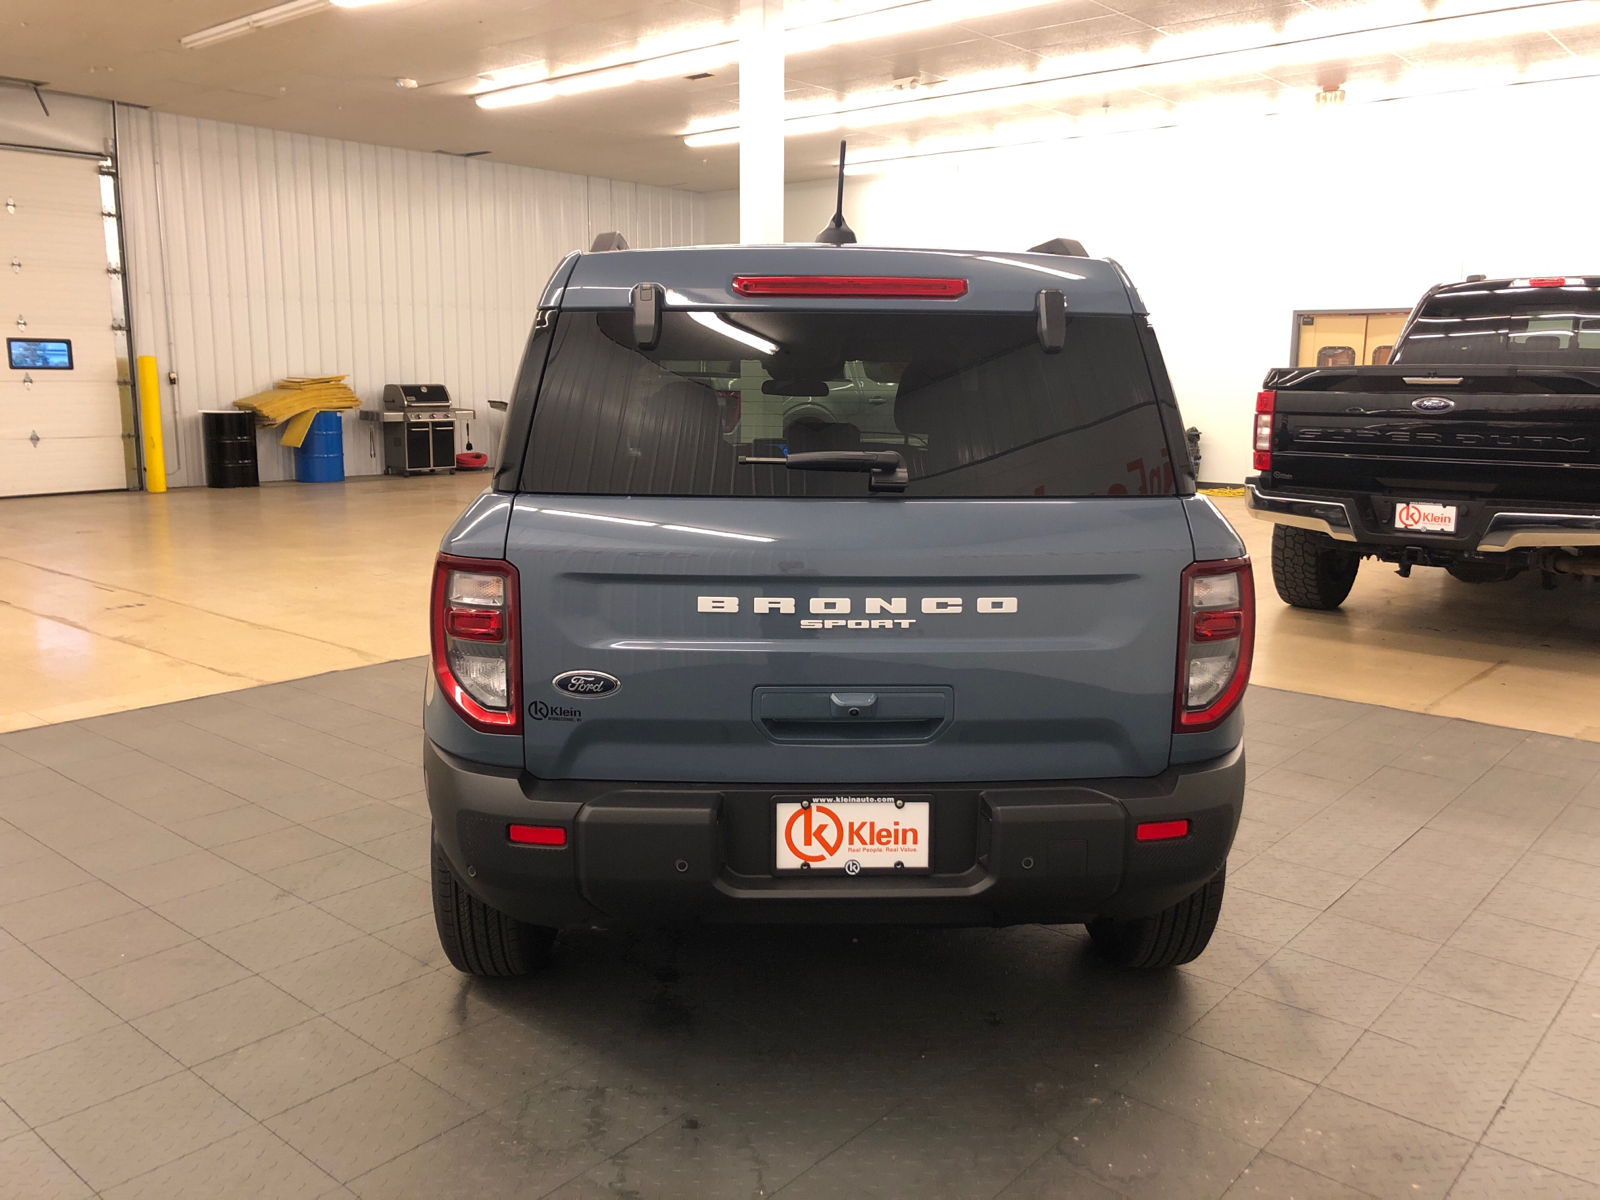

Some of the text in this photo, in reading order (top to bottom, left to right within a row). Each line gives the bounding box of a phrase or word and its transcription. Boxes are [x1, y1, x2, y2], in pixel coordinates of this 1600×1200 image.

[1299, 428, 1586, 447] SUPER DUTY
[1422, 512, 1451, 523] Klein
[697, 596, 1018, 614] BRONCO
[800, 619, 917, 629] SPORT
[567, 676, 604, 692] Ford
[550, 706, 582, 717] Klein
[848, 821, 918, 846] Klein
